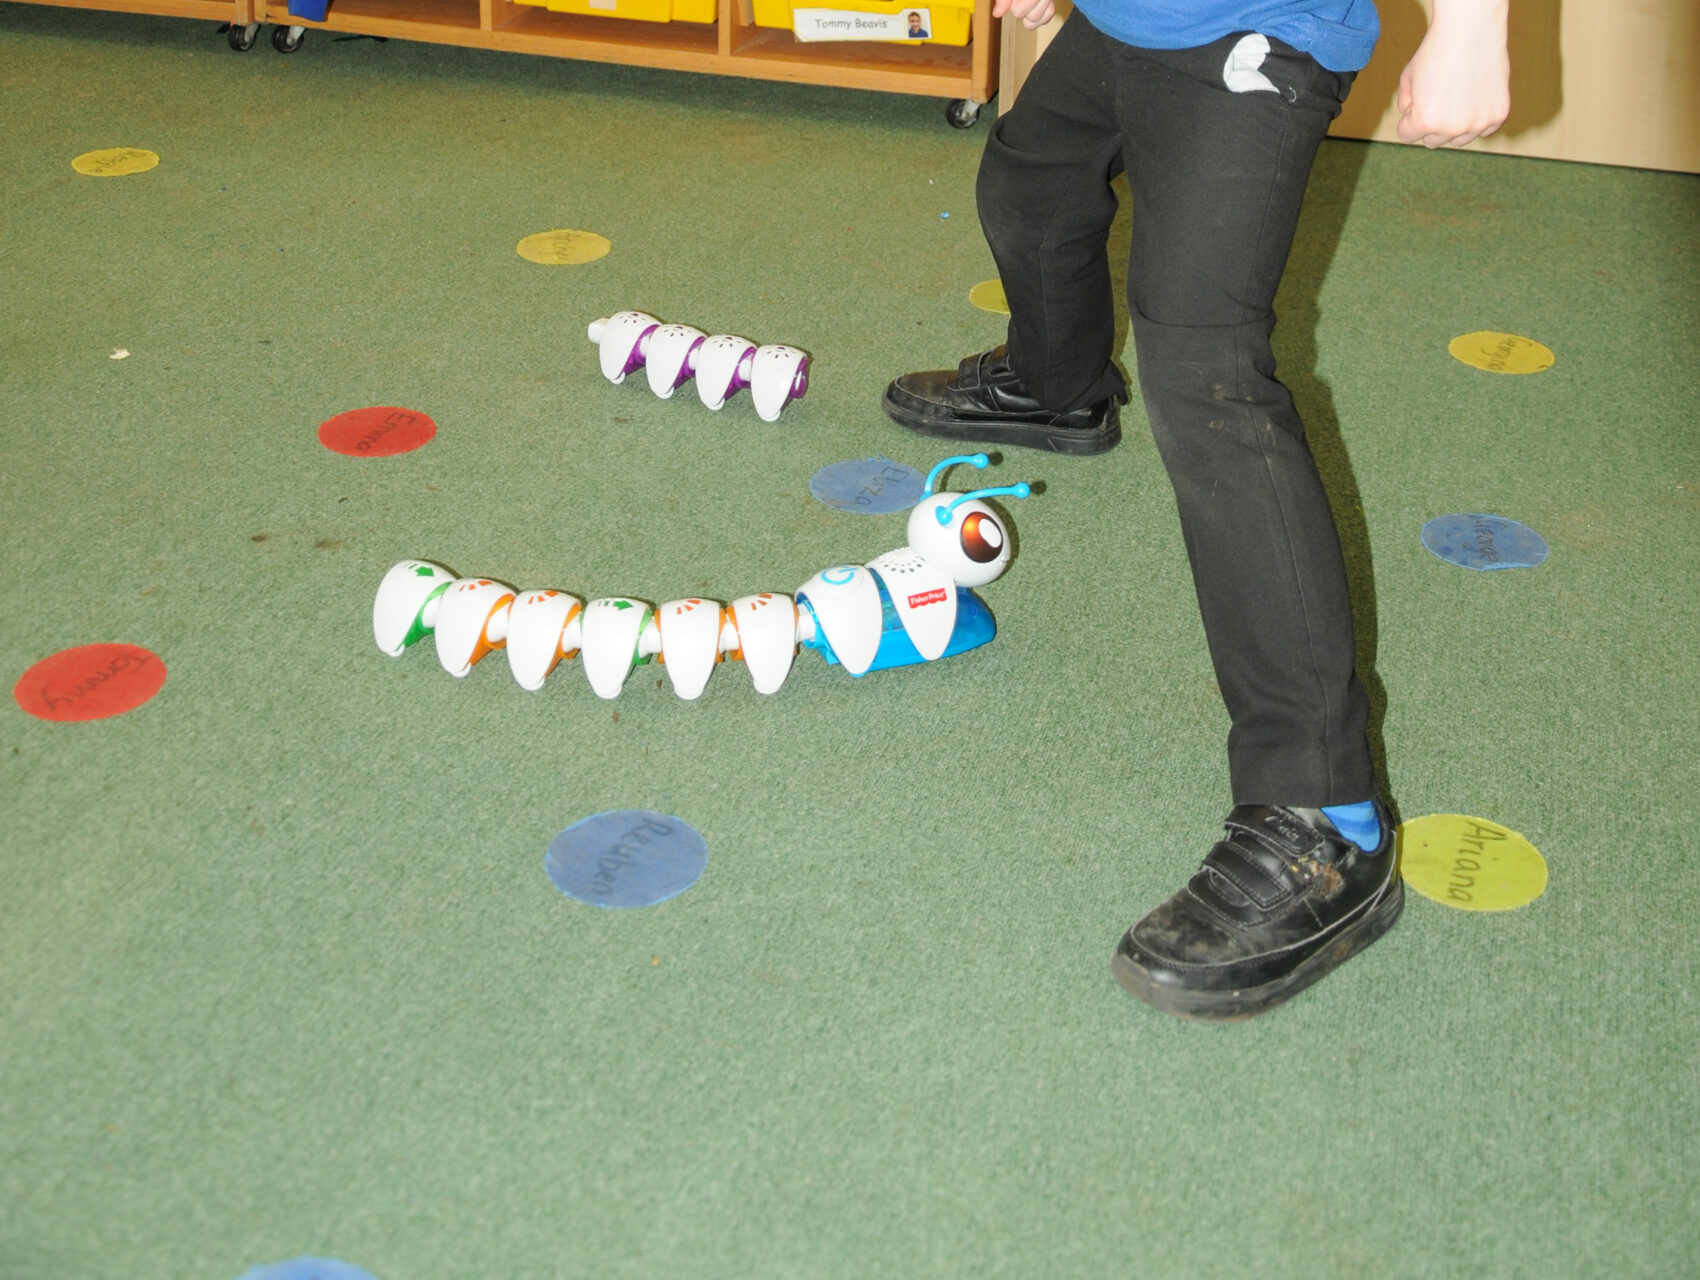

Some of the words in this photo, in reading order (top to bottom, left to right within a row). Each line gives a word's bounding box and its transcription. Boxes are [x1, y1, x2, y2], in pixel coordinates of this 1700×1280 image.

[814, 16, 850, 32] Tommy
[855, 17, 887, 29] Beavis
[354, 412, 417, 451] Emma
[854, 466, 909, 506] Eliza
[41, 654, 154, 710] Tommy
[590, 818, 675, 896] Reuben
[1446, 820, 1508, 902] Ariana
